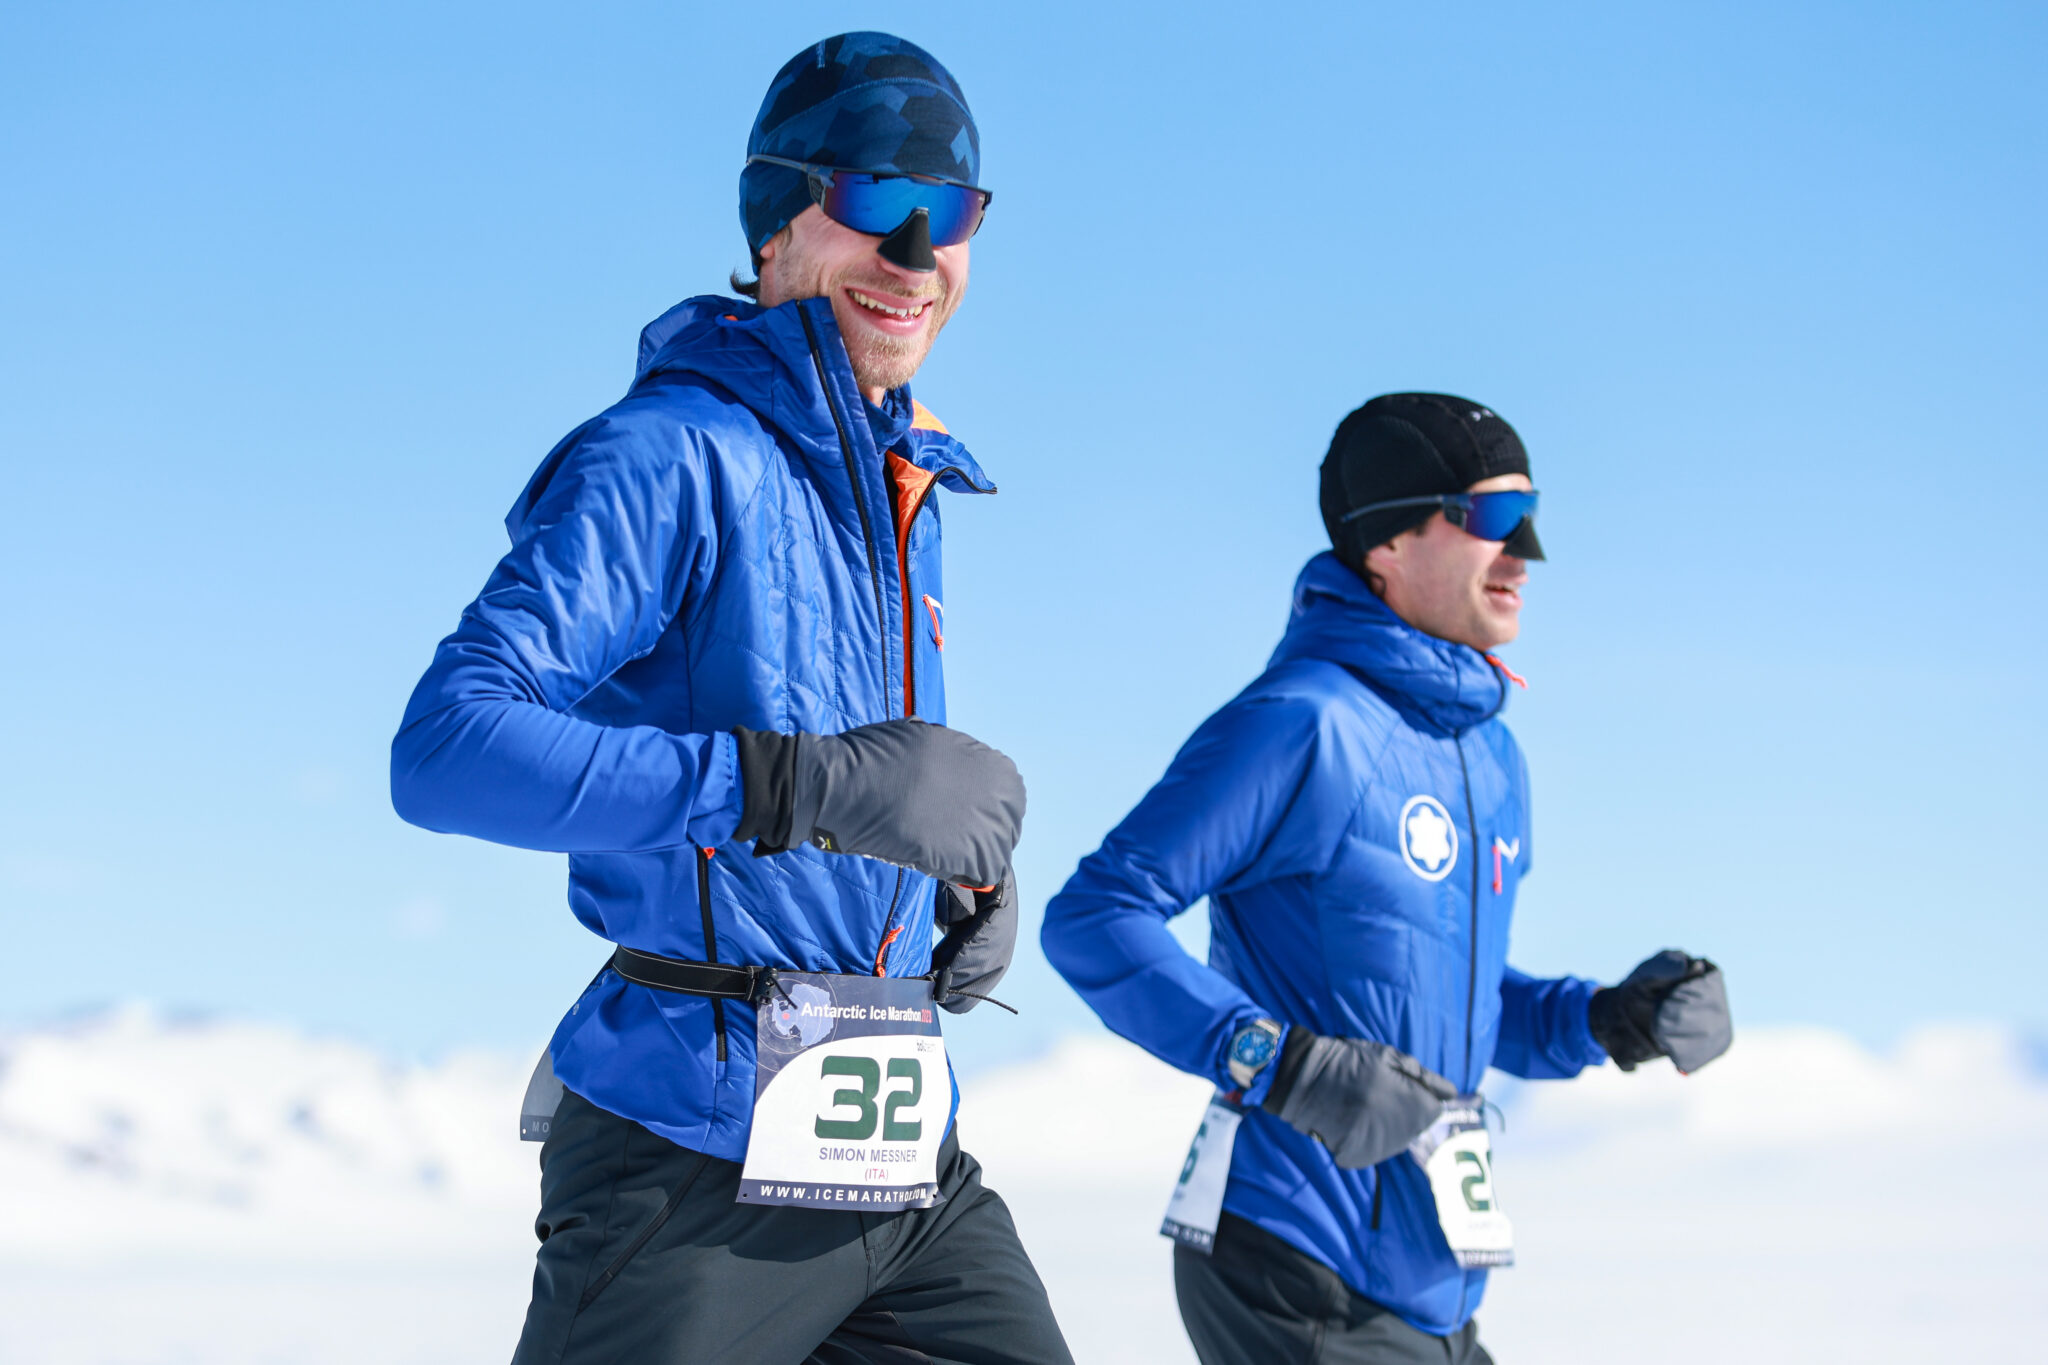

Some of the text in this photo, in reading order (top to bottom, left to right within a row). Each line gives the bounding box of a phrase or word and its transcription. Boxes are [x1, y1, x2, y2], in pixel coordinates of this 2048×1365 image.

[801, 1001, 867, 1020] Antarctic
[870, 1005, 887, 1021] Ice
[814, 1055, 923, 1142] 32
[819, 1147, 917, 1164] SIMON MESSNER
[864, 1168, 889, 1182] (ITA)
